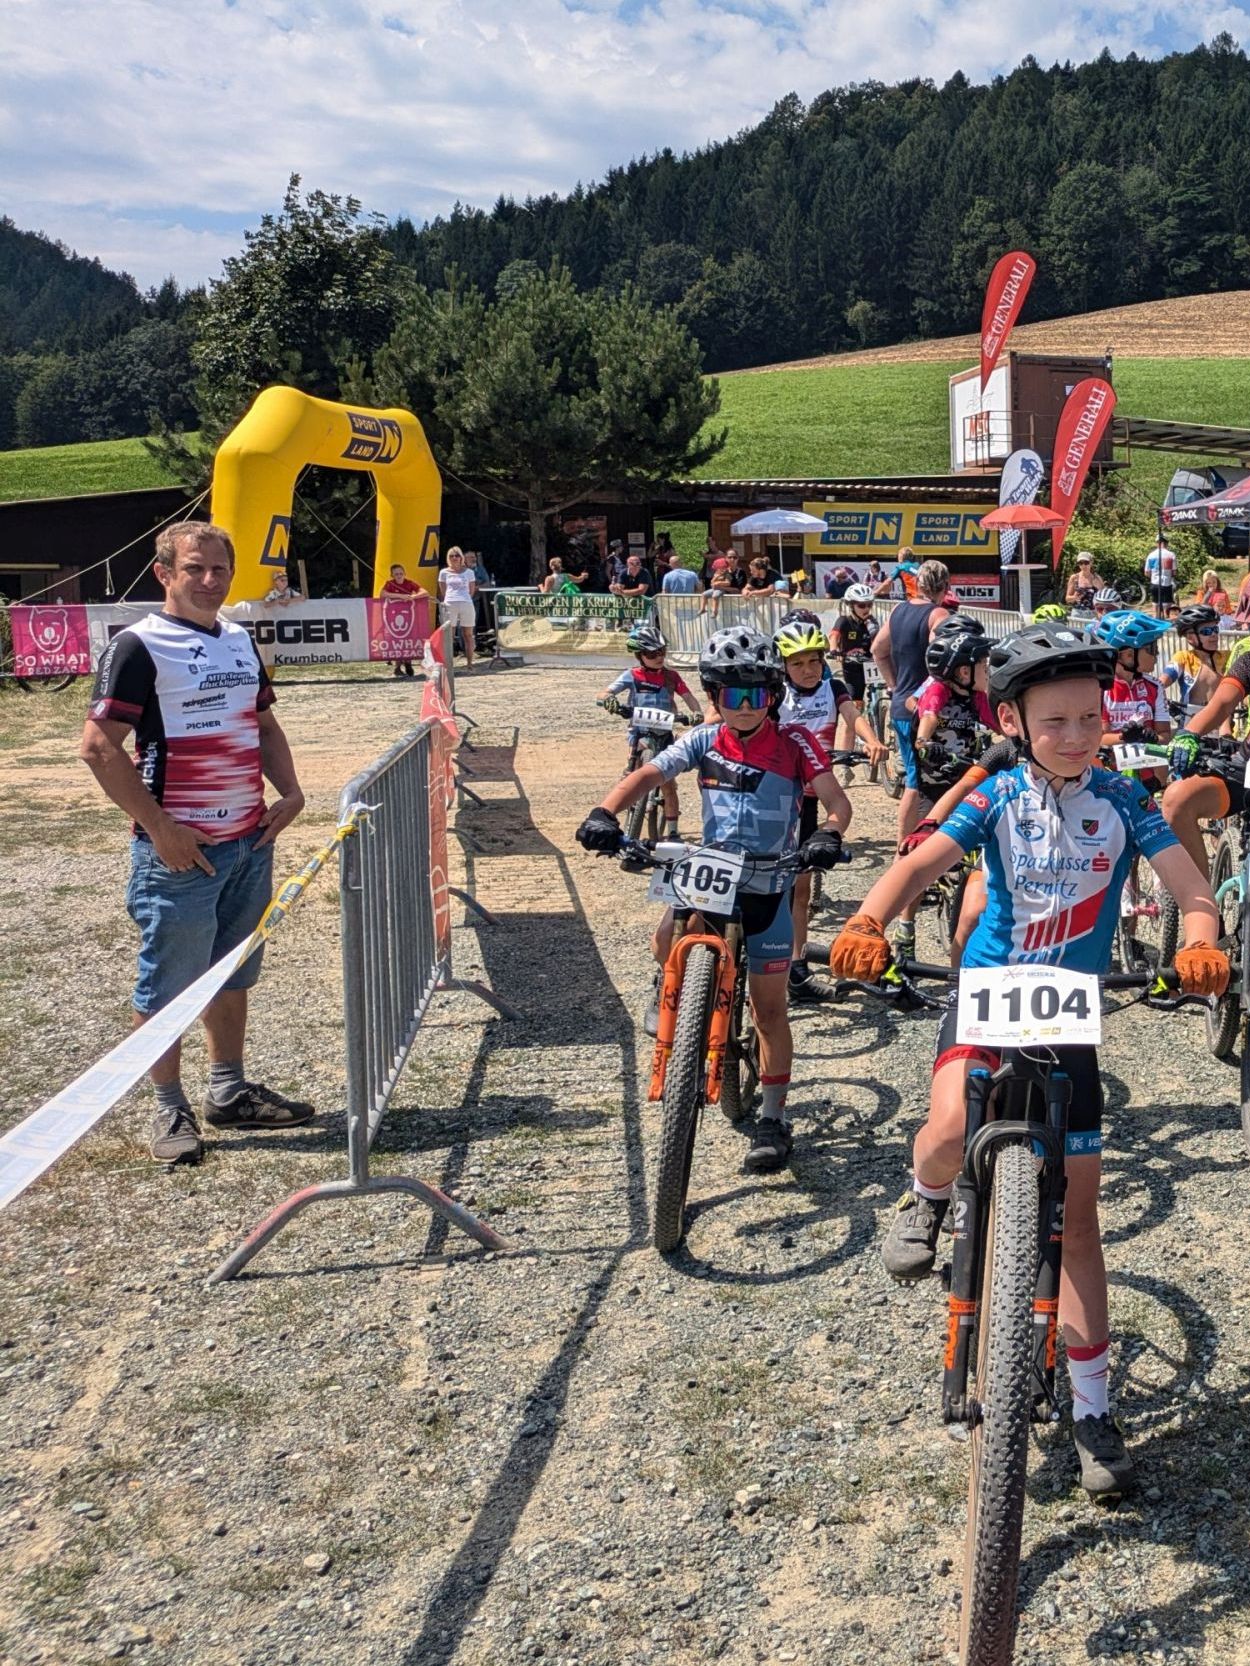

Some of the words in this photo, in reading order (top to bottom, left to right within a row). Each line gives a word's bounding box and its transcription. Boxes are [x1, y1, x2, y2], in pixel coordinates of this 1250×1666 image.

[991, 259, 1030, 336] GENERALI
[353, 417, 379, 432] SPORT
[1065, 386, 1106, 469] GENERALI
[350, 443, 374, 457] LAND
[828, 515, 865, 524] SPORT
[921, 516, 956, 525] SPORT
[829, 533, 859, 542] LAND
[922, 534, 950, 543] LAND
[587, 595, 646, 609] KRUMBACH
[553, 607, 569, 616] DER
[371, 640, 389, 652] SO
[15, 654, 37, 669] SO
[41, 653, 88, 666] WHAT
[274, 653, 343, 665] Krumbach
[637, 709, 671, 722] 1117
[186, 720, 222, 730] PICHER
[1008, 845, 1091, 873] Sparkasse
[662, 858, 734, 896] 1105
[1014, 874, 1079, 898] Pernitz
[970, 985, 1092, 1022] 1104
